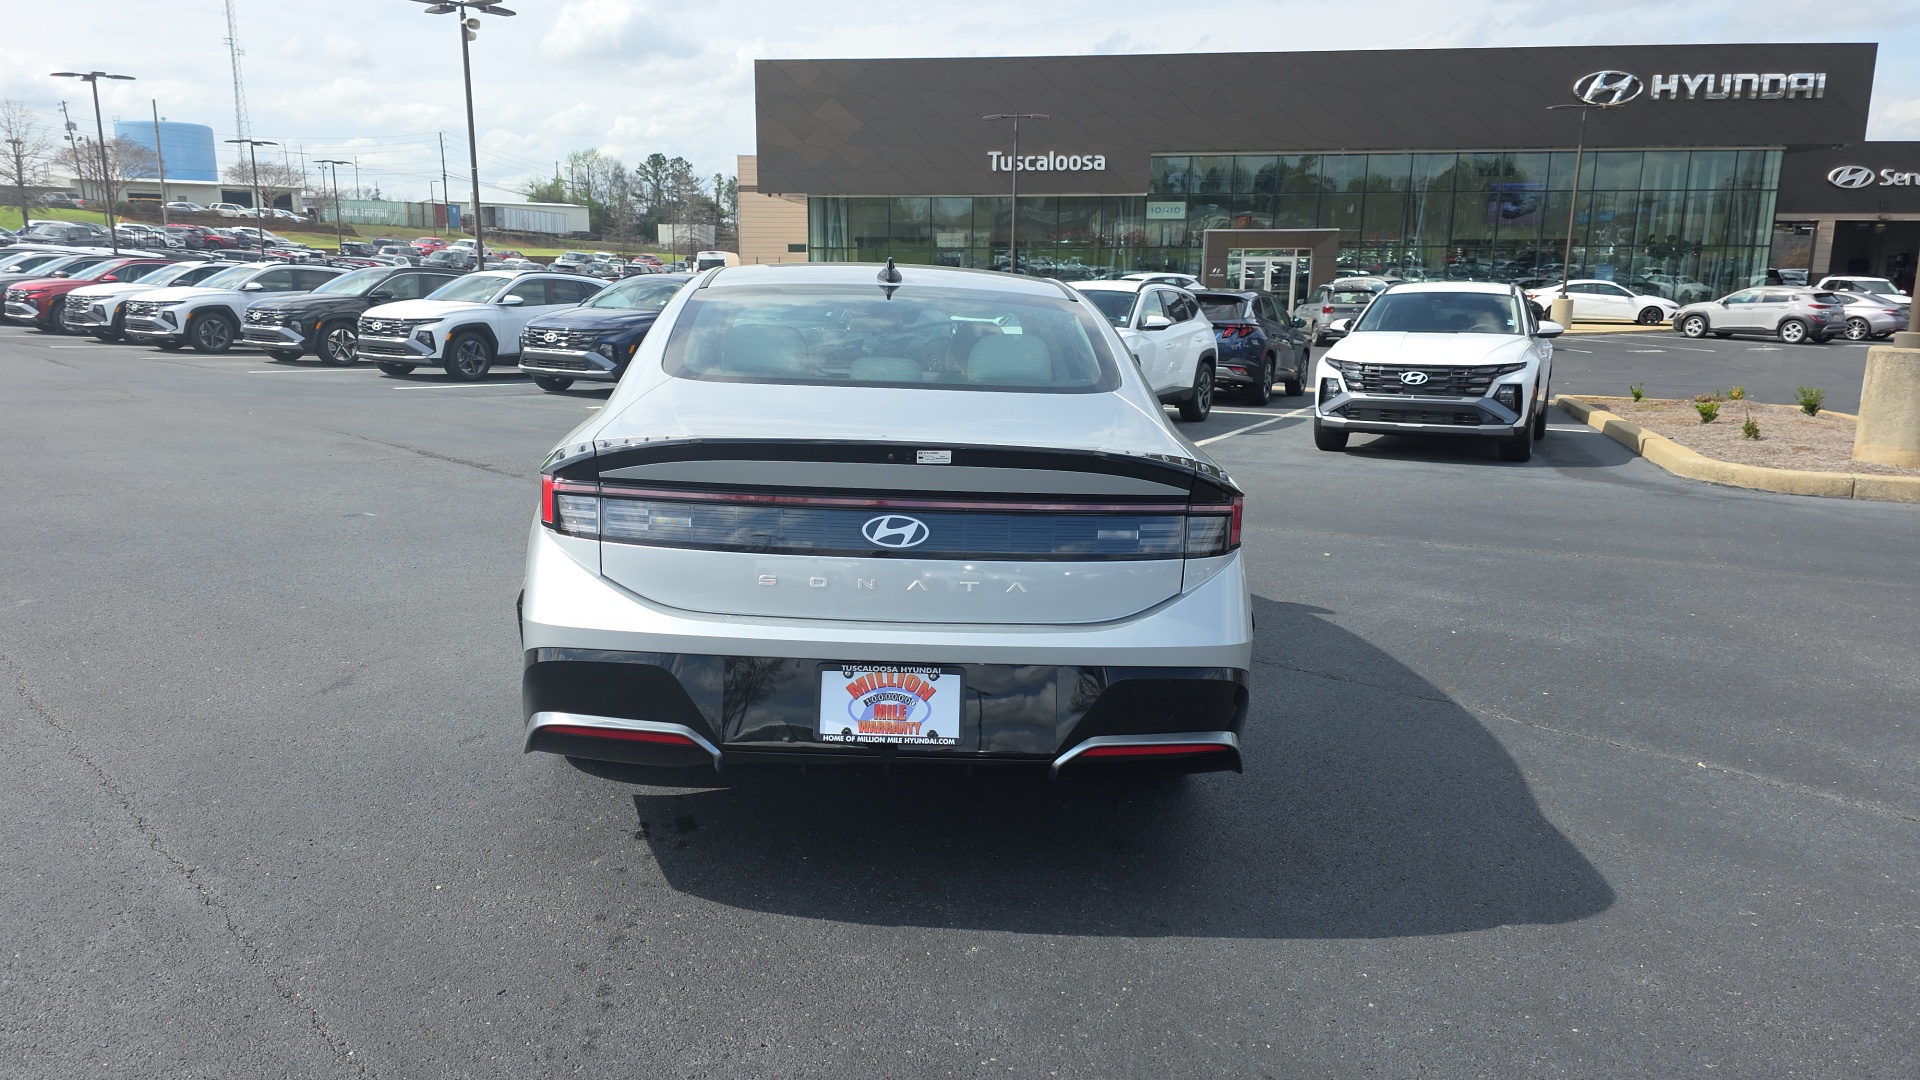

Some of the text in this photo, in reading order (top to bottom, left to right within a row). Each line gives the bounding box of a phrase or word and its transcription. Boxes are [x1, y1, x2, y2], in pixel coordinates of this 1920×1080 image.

[1650, 72, 1827, 100] HYUNDAI
[987, 150, 1106, 172] Tuscaloosa
[758, 574, 1028, 593] SONATA
[841, 665, 941, 674] TUSCALOOSA HYUNDAI
[845, 672, 937, 702] MILLION
[873, 704, 907, 721] MILE
[858, 720, 922, 735] WARRANTY
